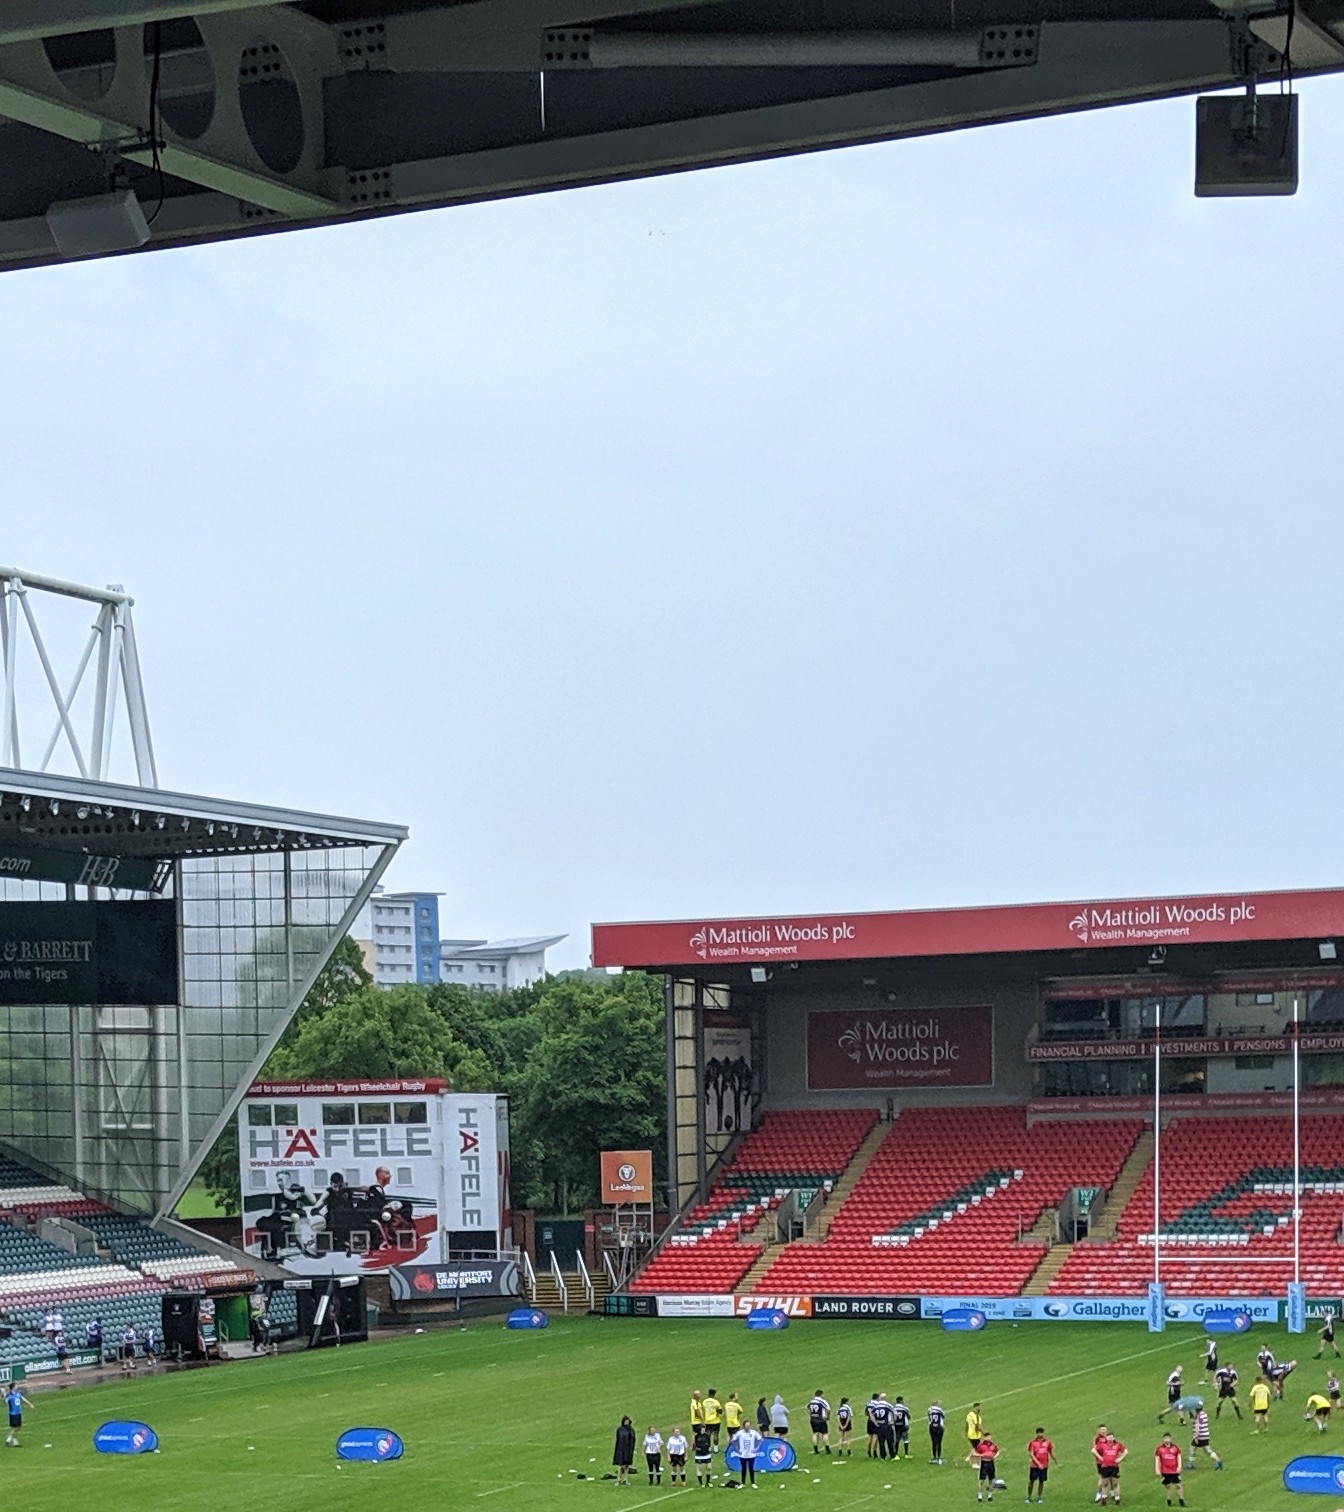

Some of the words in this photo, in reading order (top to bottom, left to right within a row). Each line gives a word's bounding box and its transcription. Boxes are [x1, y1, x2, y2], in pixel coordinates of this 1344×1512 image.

[1091, 906, 1160, 927] Mattioli
[1165, 904, 1226, 923] Woods
[1229, 902, 1256, 925] plc
[709, 926, 771, 945] Mattioli
[774, 923, 829, 942] Woods
[832, 922, 856, 943] plc
[1091, 928, 1125, 940] Wealth
[1127, 927, 1190, 940] Management
[3, 941, 18, 962] &
[16, 941, 93, 963] BARRETT
[709, 945, 739, 957] Wealth
[741, 944, 797, 957] Management
[13, 967, 33, 980] the
[34, 967, 69, 984] Tigers
[865, 1019, 940, 1041] Mattioli
[866, 1042, 929, 1062] Woods
[932, 1040, 960, 1065] plc
[1030, 1045, 1082, 1058] FINANCIAL
[1084, 1043, 1136, 1057] PLANNING
[1150, 1041, 1220, 1054] IVESTMENTS
[1233, 1038, 1286, 1051] PENSIONS
[249, 1127, 432, 1158] HÄFELE
[458, 1107, 481, 1227] HÄFELE
[814, 1302, 850, 1313] LAND
[852, 1301, 894, 1313] ROVER
[1072, 1302, 1146, 1319] Gallagher
